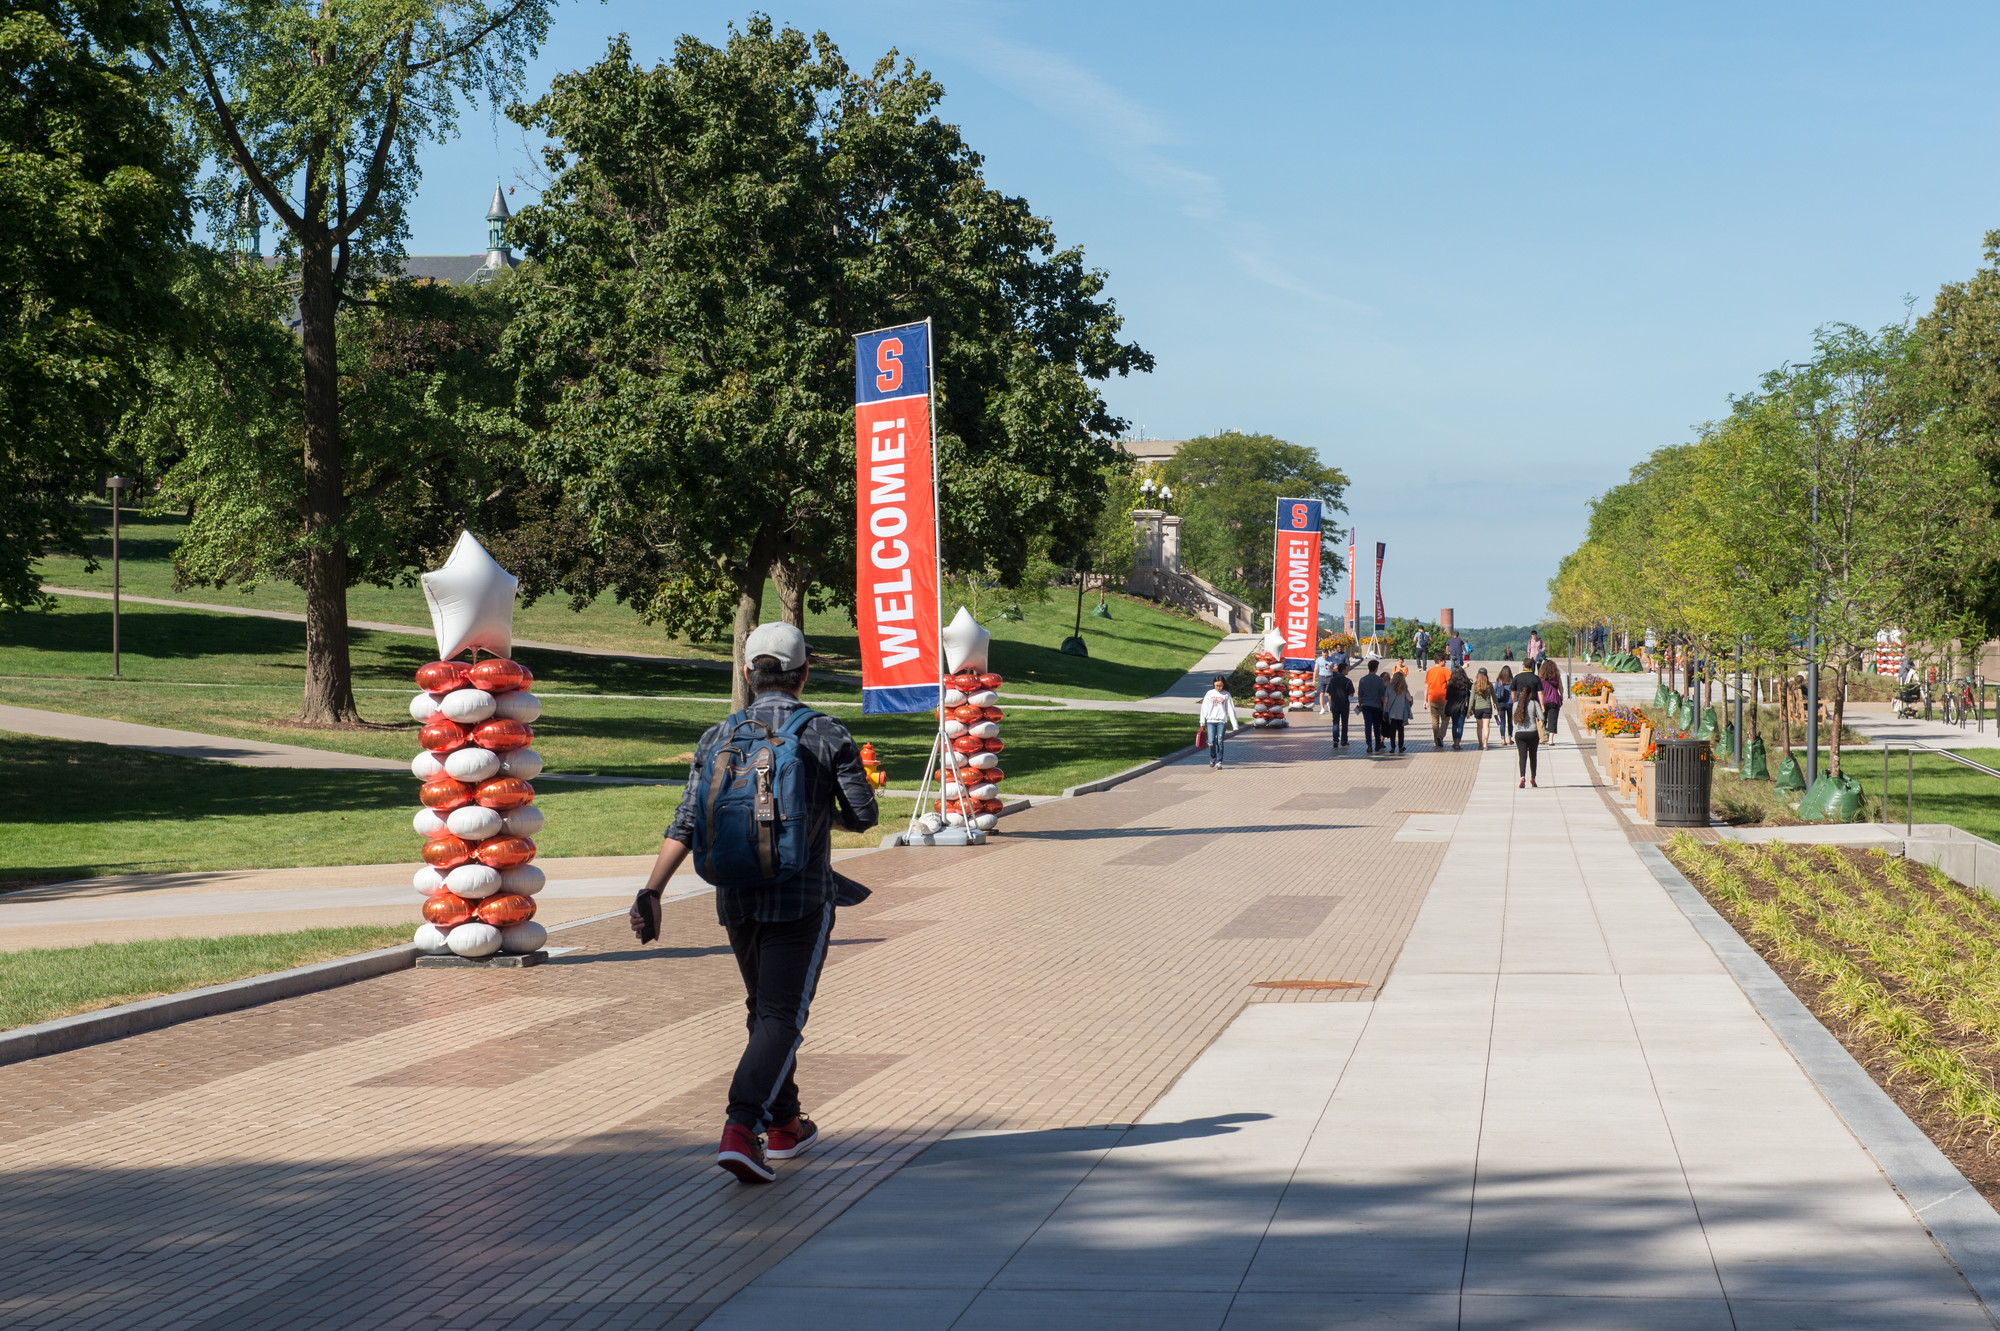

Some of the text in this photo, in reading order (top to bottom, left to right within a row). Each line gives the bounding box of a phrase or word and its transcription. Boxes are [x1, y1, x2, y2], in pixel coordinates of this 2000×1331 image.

[876, 337, 903, 393] S
[870, 417, 920, 668] WELCOME!
[1292, 504, 1307, 528] S
[1287, 539, 1310, 650] WELCOME!
